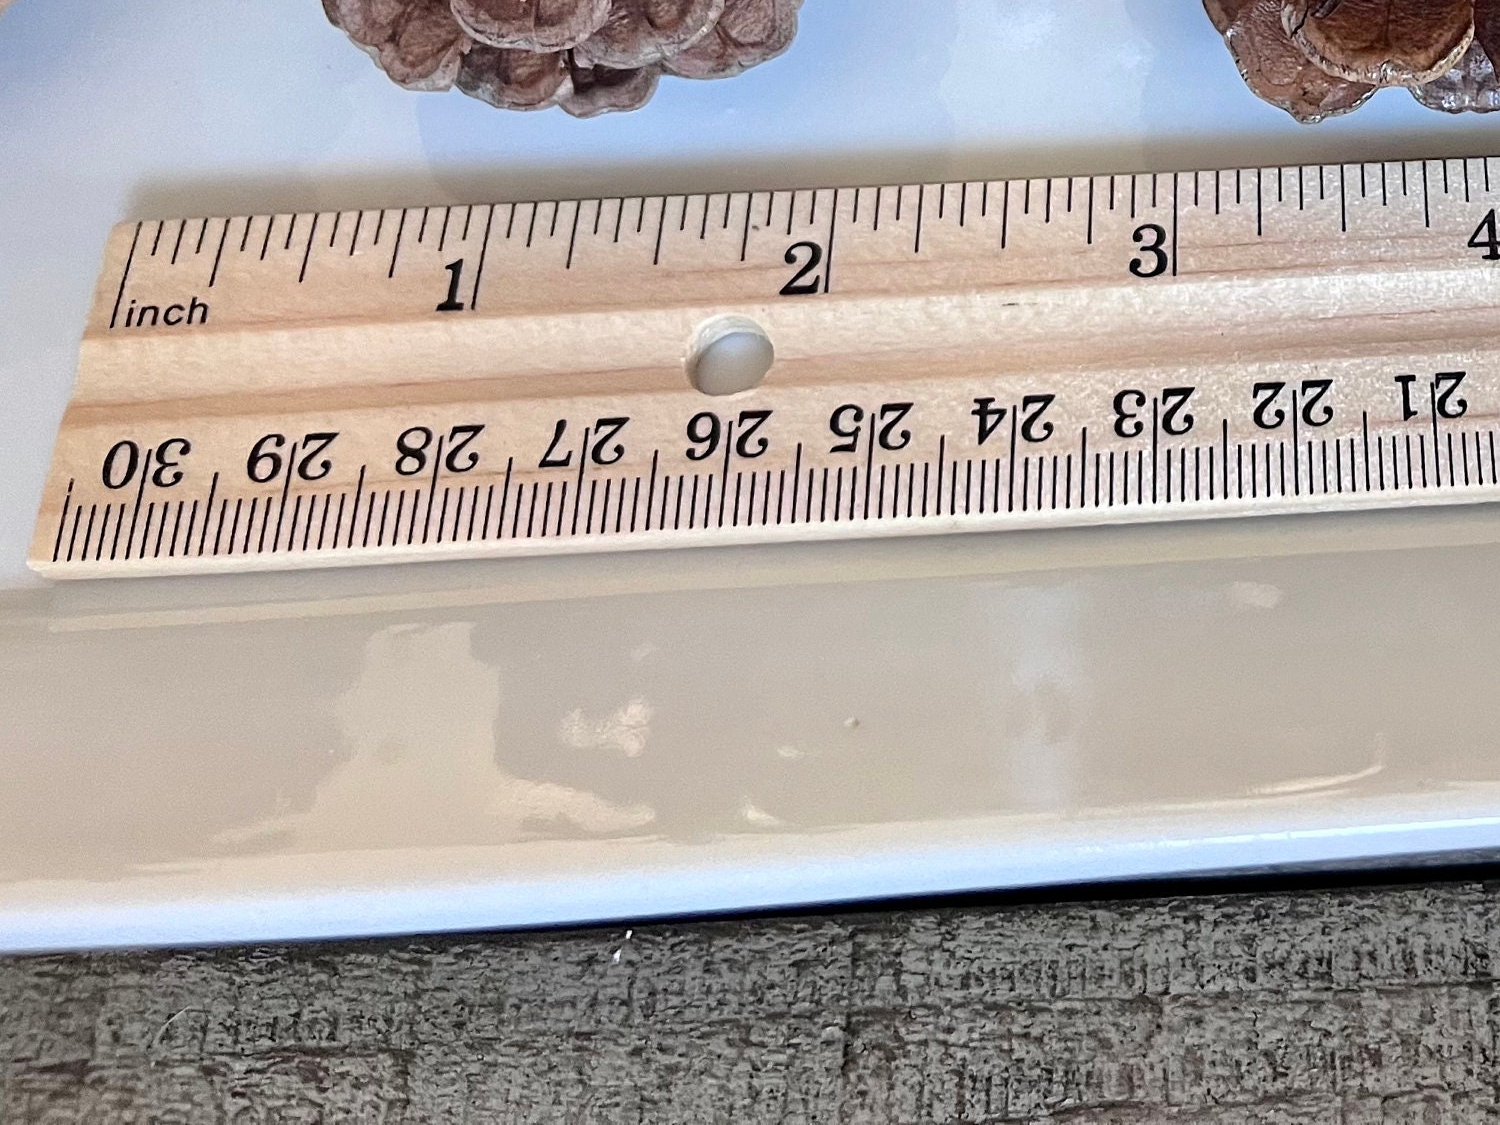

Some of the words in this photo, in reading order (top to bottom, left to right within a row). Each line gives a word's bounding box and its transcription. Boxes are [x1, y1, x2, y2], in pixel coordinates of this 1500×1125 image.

[436, 259, 465, 312] 1
[779, 242, 823, 295] 2
[1129, 224, 1168, 277] 3
[125, 297, 209, 327] inch
[971, 394, 1057, 443] 24
[1112, 387, 1196, 438] 23
[1251, 379, 1335, 429] 22
[1395, 372, 1467, 421] 21
[395, 424, 485, 475] 28
[538, 416, 630, 467] 27
[685, 410, 774, 460] 26
[829, 402, 915, 453] 25
[102, 437, 191, 489] 30
[246, 432, 340, 481] 29
